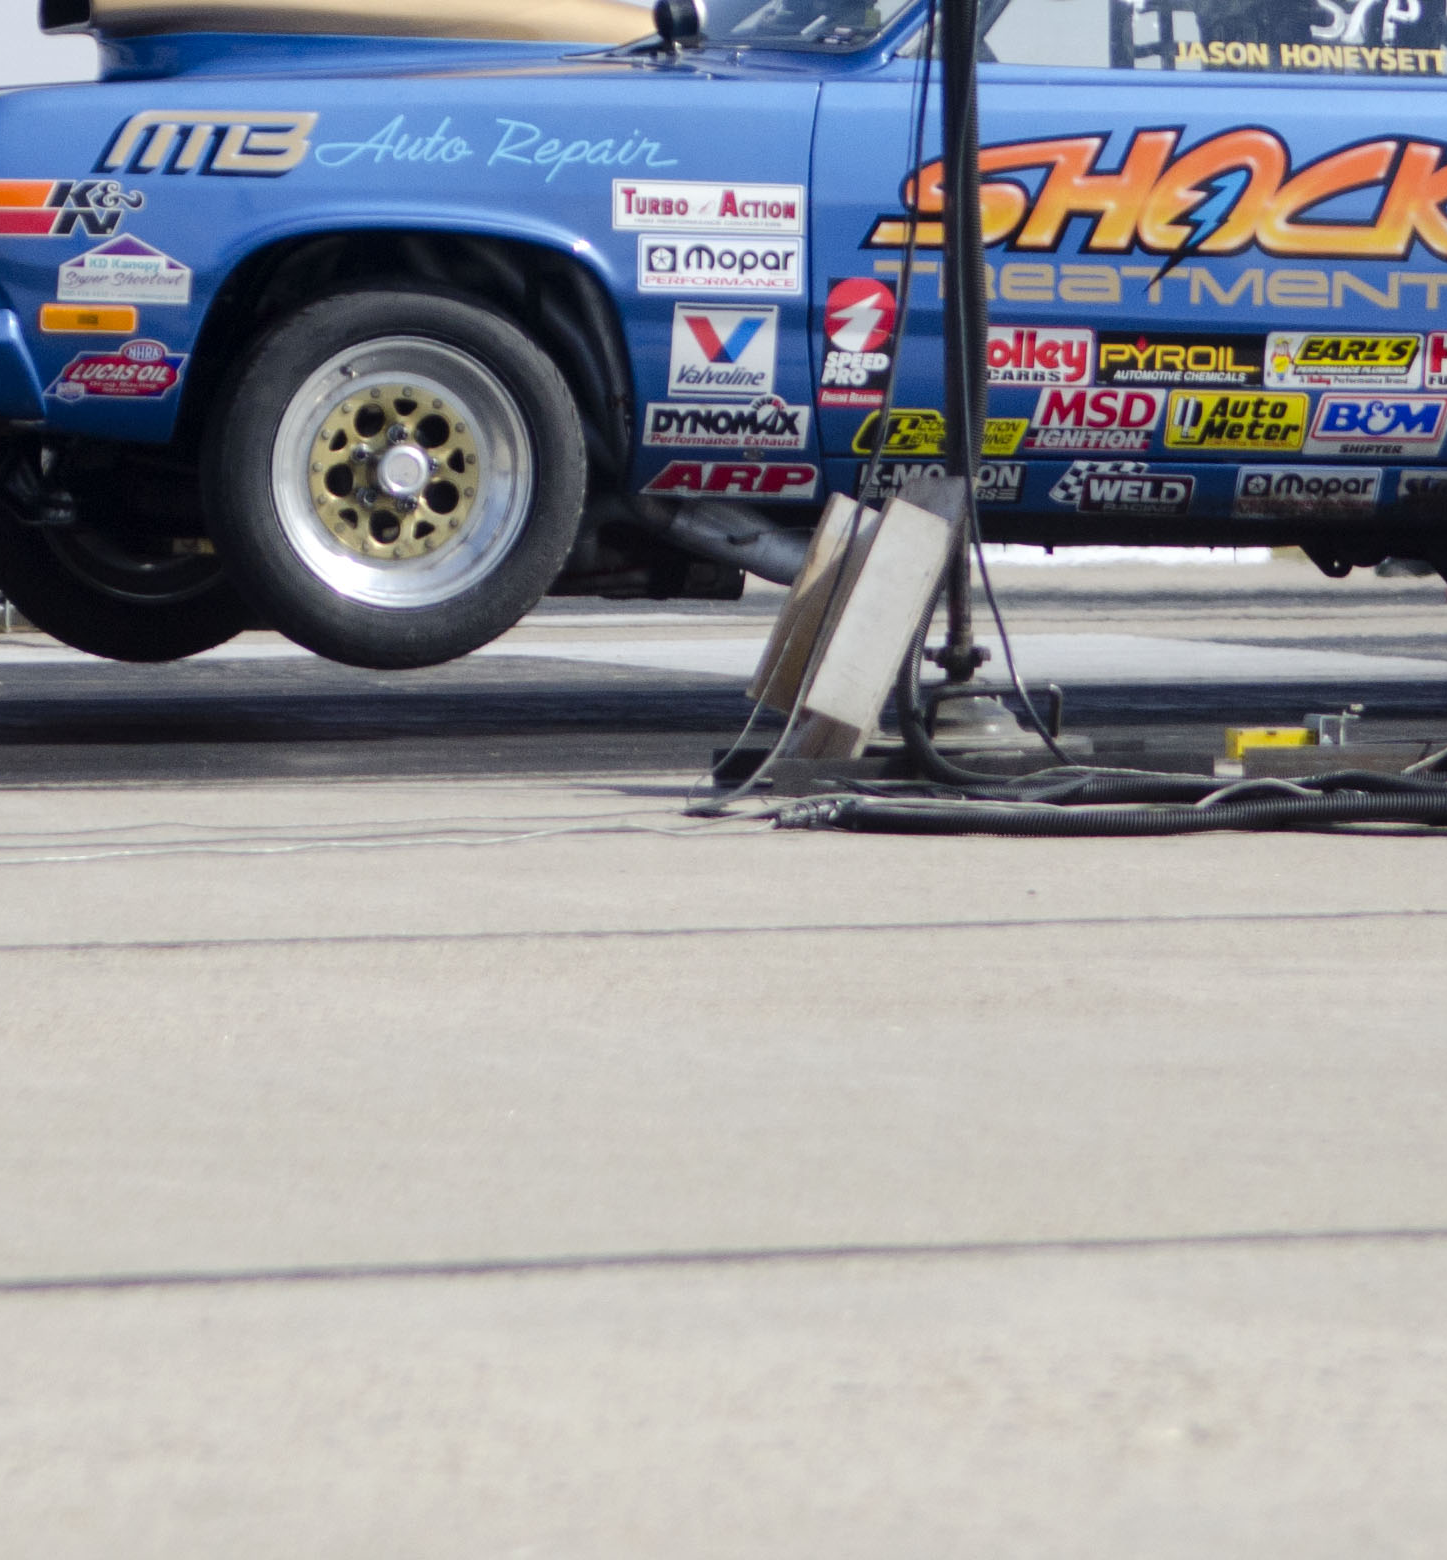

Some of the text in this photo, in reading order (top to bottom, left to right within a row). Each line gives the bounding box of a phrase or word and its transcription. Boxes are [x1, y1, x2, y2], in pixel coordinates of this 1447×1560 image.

[1176, 40, 1447, 73] JASON HONEYSETT
[315, 114, 678, 183] Auto Repair
[684, 243, 795, 275] Mopar
[644, 274, 795, 288] PERFORMANCE
[128, 346, 163, 362] NHRA
[824, 350, 891, 371] SPEED
[987, 329, 1089, 383] olley
[1100, 342, 1261, 373] PYROIL
[1299, 338, 1413, 363] EARL'S
[68, 363, 172, 382] LUCAS OIL
[675, 364, 766, 386] Valvoline
[820, 368, 869, 386] PRO
[1113, 370, 1247, 383] AUTOMOTIVE CHEMICALS
[1040, 389, 1157, 429] MSD
[1209, 396, 1290, 420] Auto
[1319, 400, 1444, 437] B&M
[653, 408, 801, 436] DYNOMAX
[1199, 418, 1301, 442] Meter
[652, 433, 799, 447] Performance Exhaust
[1033, 428, 1141, 449] IGNITION
[1338, 443, 1403, 455] SHIFTER
[647, 462, 817, 494] ARP
[1272, 473, 1377, 497] Mopar
[1089, 478, 1188, 504] WELD
